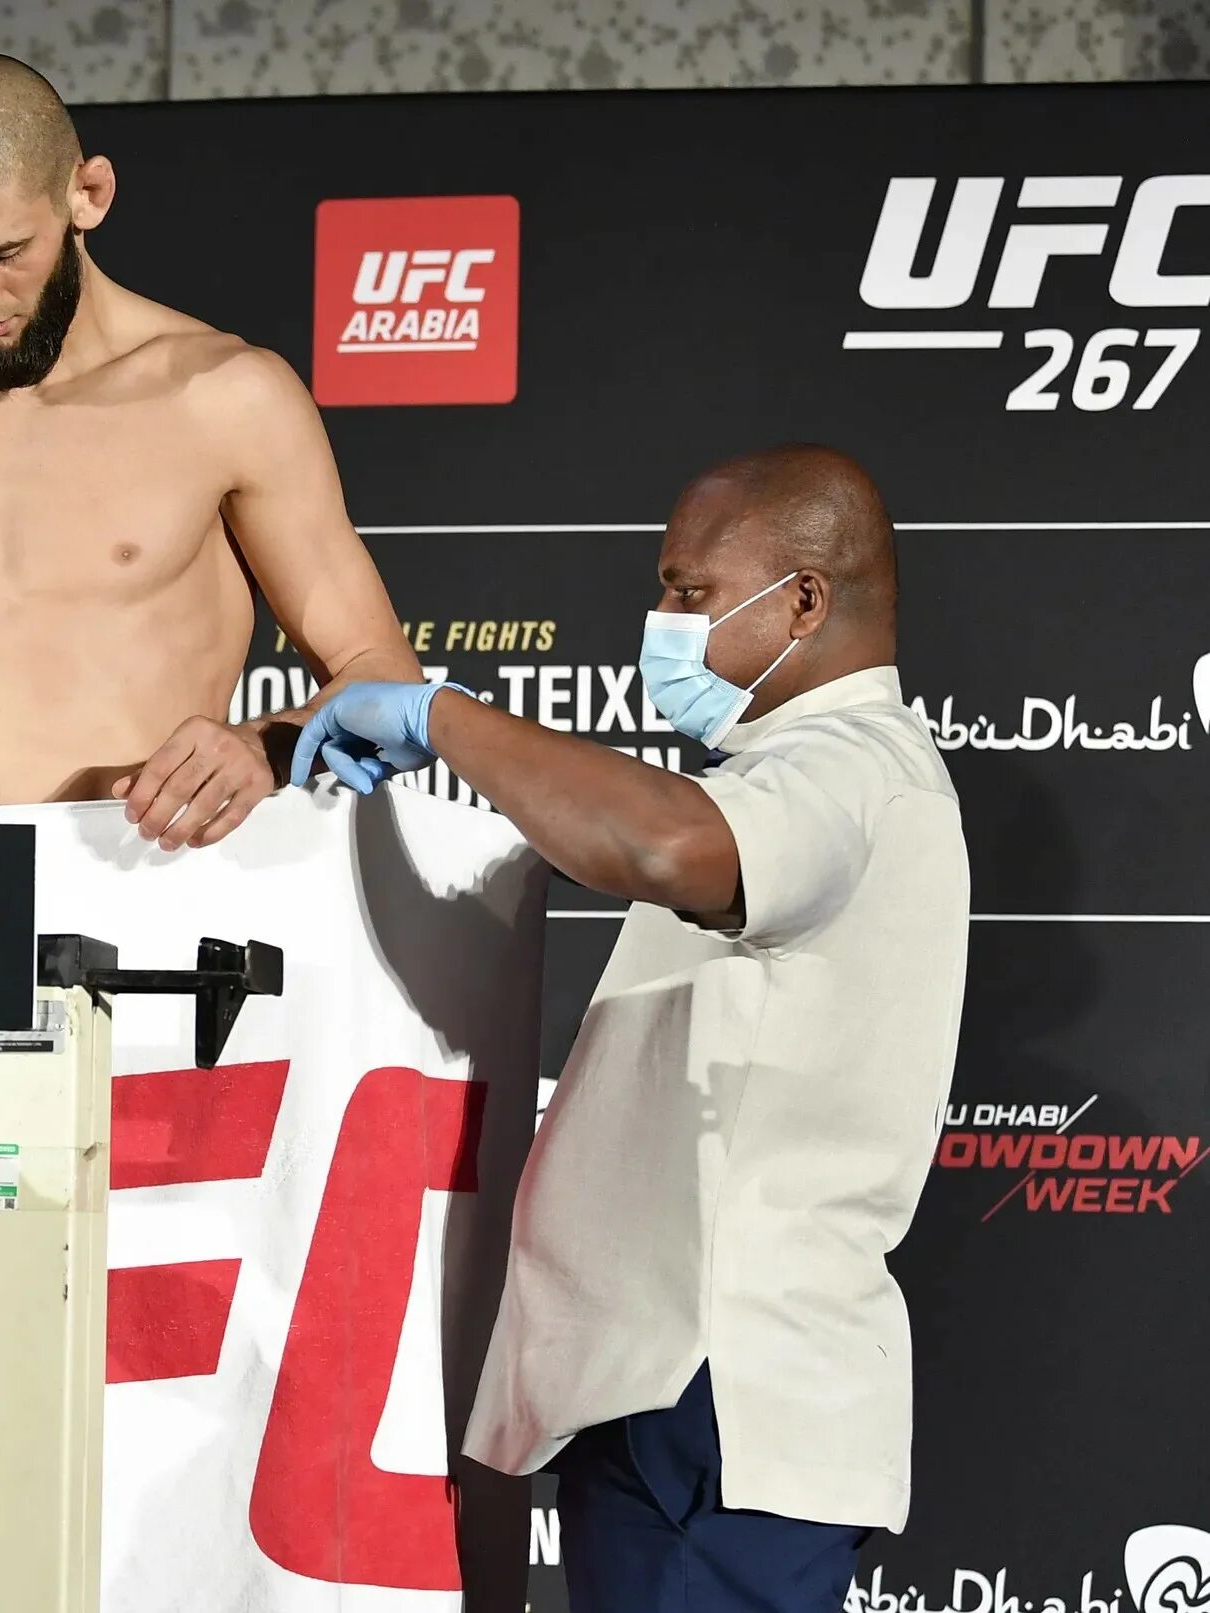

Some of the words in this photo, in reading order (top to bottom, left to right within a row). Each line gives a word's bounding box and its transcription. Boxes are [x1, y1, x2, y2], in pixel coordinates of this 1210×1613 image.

[859, 174, 1210, 309] UFC
[352, 249, 496, 304] UFC
[341, 308, 480, 342] ARABIA
[1005, 327, 1202, 411] 267
[445, 620, 557, 652] FIGHTS
[973, 1104, 1068, 1127] DHABI
[932, 1132, 1200, 1171] OWDOWN
[1025, 1177, 1178, 1214] WEEK
